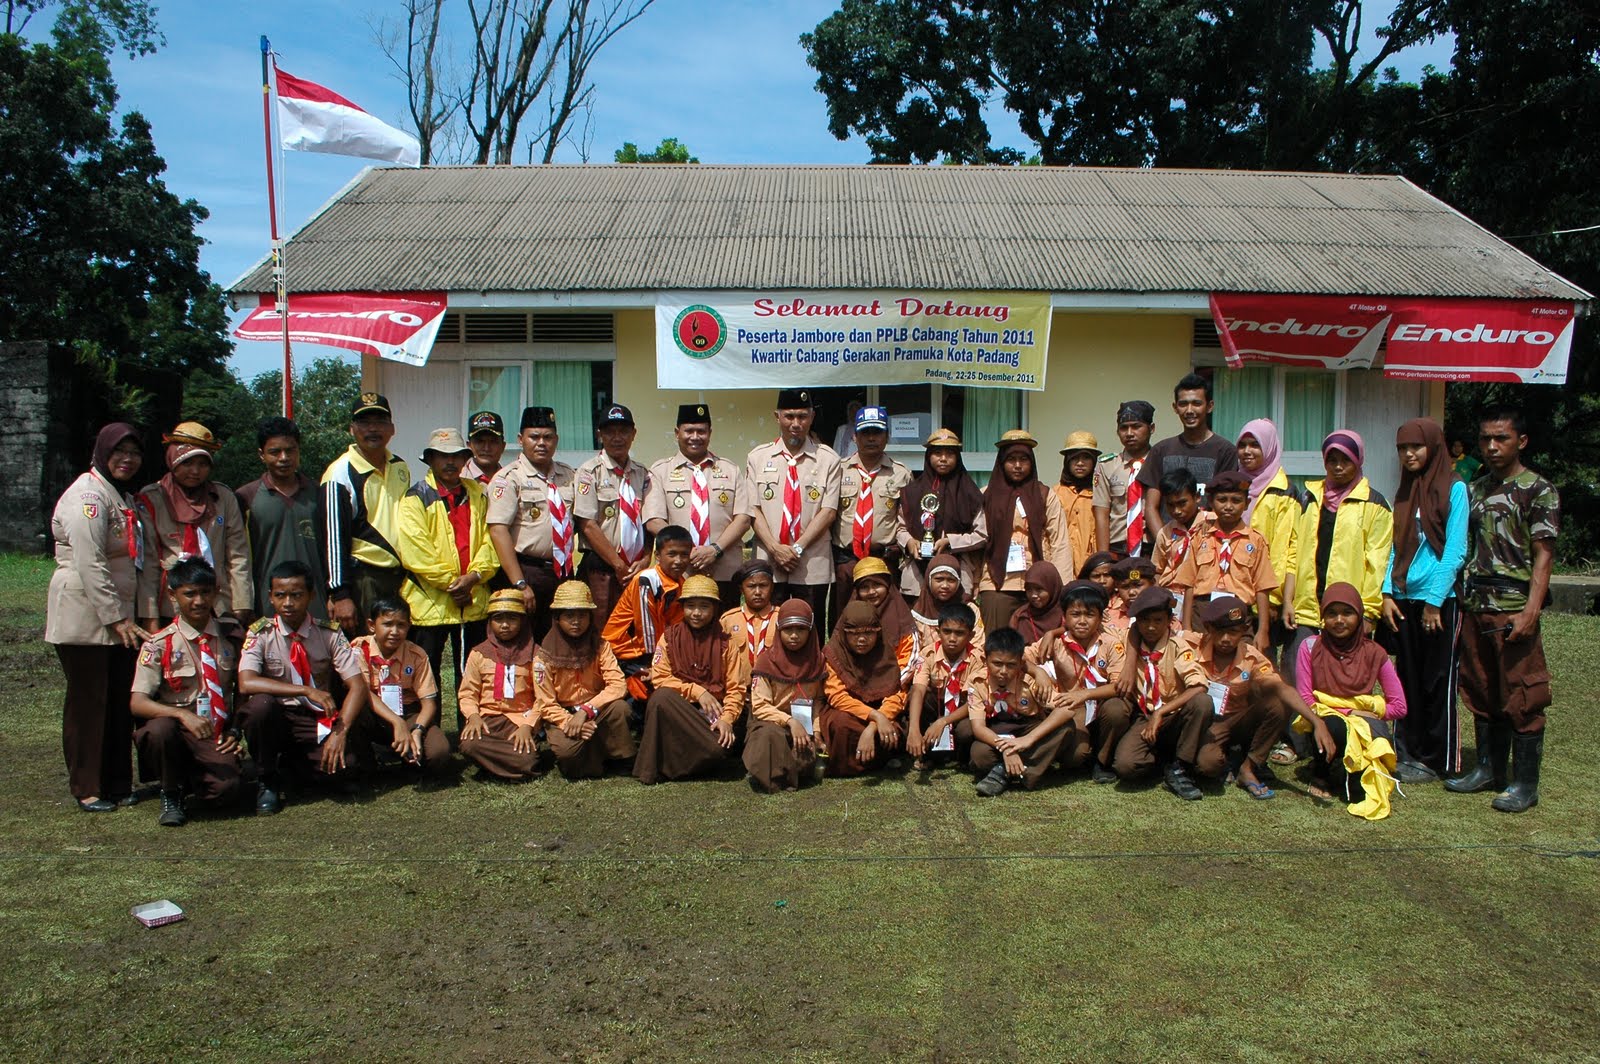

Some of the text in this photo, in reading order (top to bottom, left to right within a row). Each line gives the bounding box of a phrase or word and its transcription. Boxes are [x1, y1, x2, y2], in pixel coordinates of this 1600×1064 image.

[754, 298, 1009, 322] Selamat Datang
[737, 327, 1034, 345] Peserta Jambore dan PPLB Cabang Tahun 2011
[1391, 323, 1555, 345] Enduro
[751, 346, 1020, 367] Kwartir Cabang Gerakan Pramuka Kota Padang
[925, 368, 1035, 383] Padang, 22-25 Desember 2011
